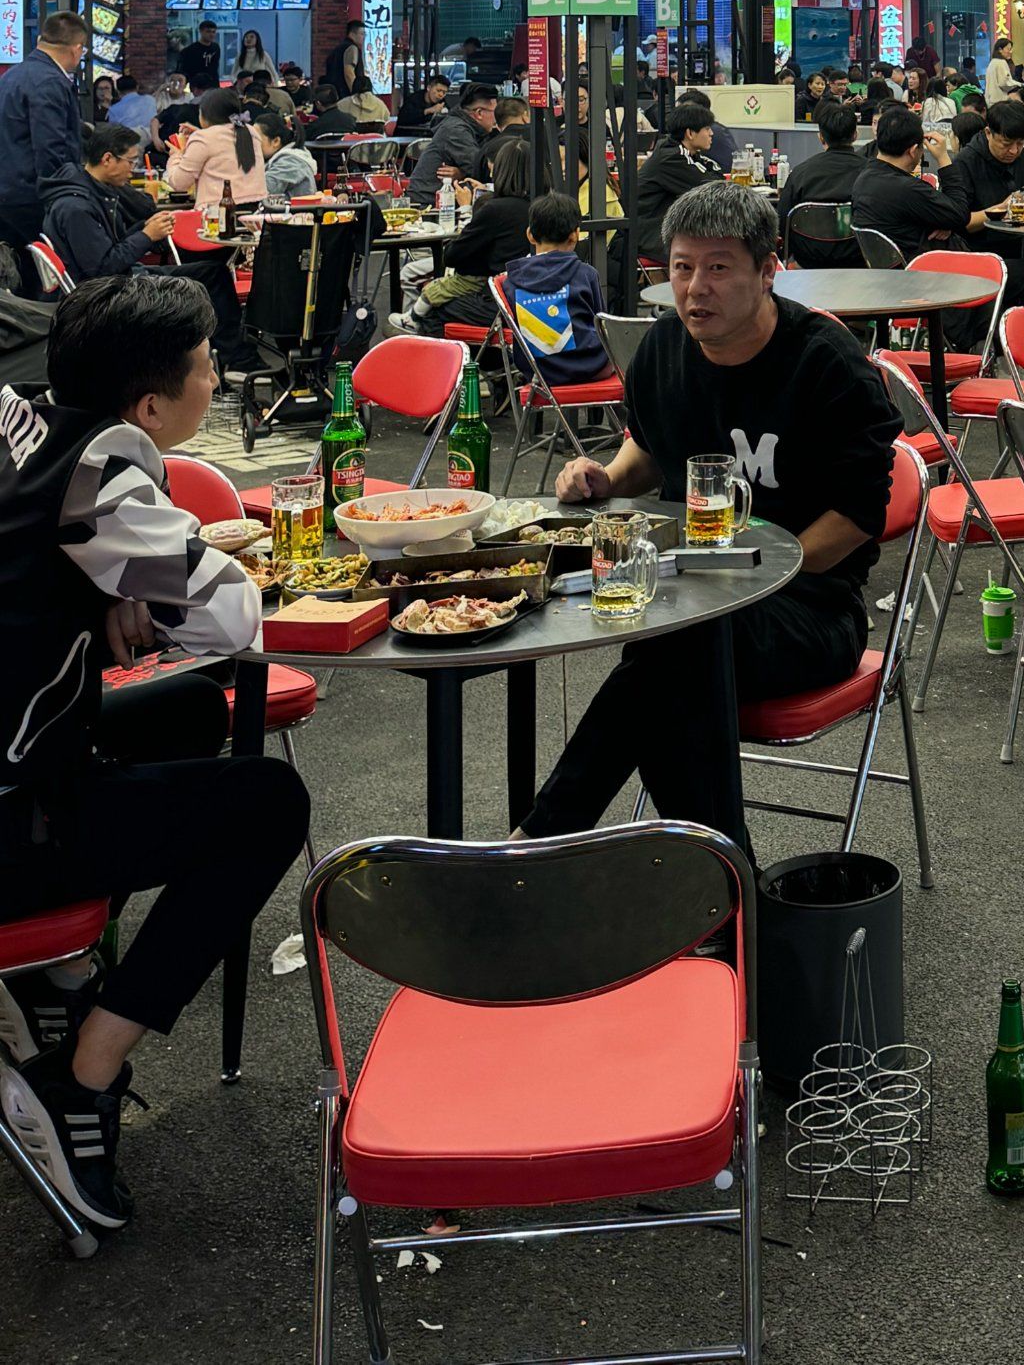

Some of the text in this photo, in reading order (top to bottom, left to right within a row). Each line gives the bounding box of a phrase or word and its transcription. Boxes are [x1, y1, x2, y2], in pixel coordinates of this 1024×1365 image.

[345, 383, 353, 407] 1903
[459, 385, 467, 409] 1903
[730, 428, 780, 489] M
[336, 468, 364, 480] TSINGT
